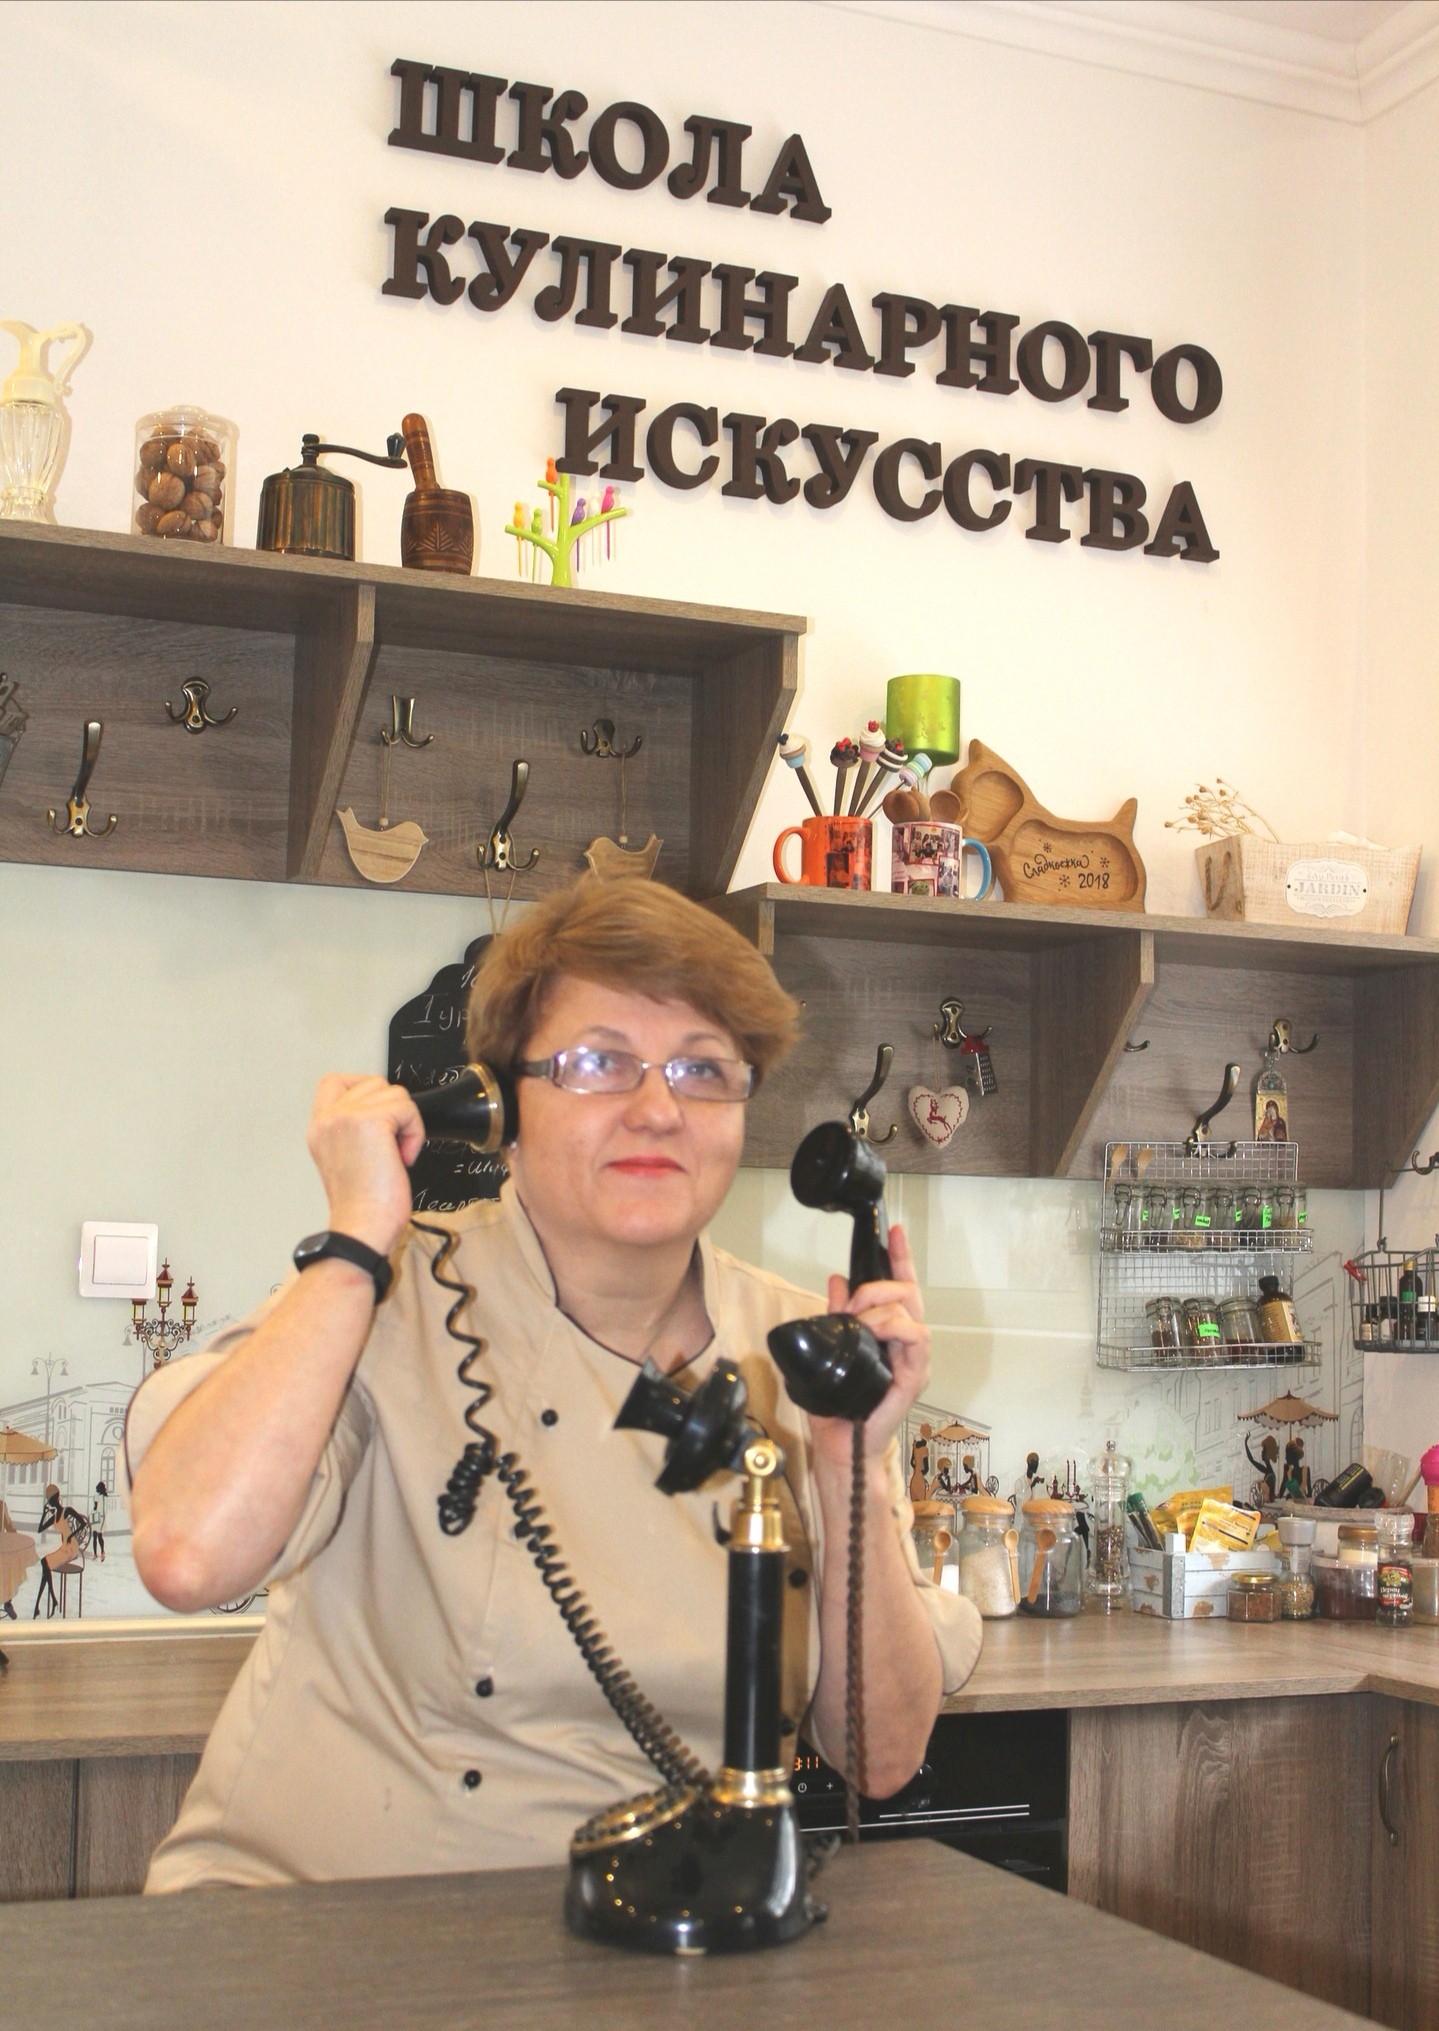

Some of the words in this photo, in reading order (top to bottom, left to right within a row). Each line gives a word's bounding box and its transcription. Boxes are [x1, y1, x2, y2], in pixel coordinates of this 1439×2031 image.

[388, 58, 832, 224] ШКОЛА
[382, 207, 1223, 423] КУЛИНАРНОГО
[555, 387, 1220, 563] ИСКУССТВА
[1023, 853, 1090, 879] Сладкоежка
[1077, 872, 1110, 890] 2018
[1294, 881, 1361, 896] JARDIN
